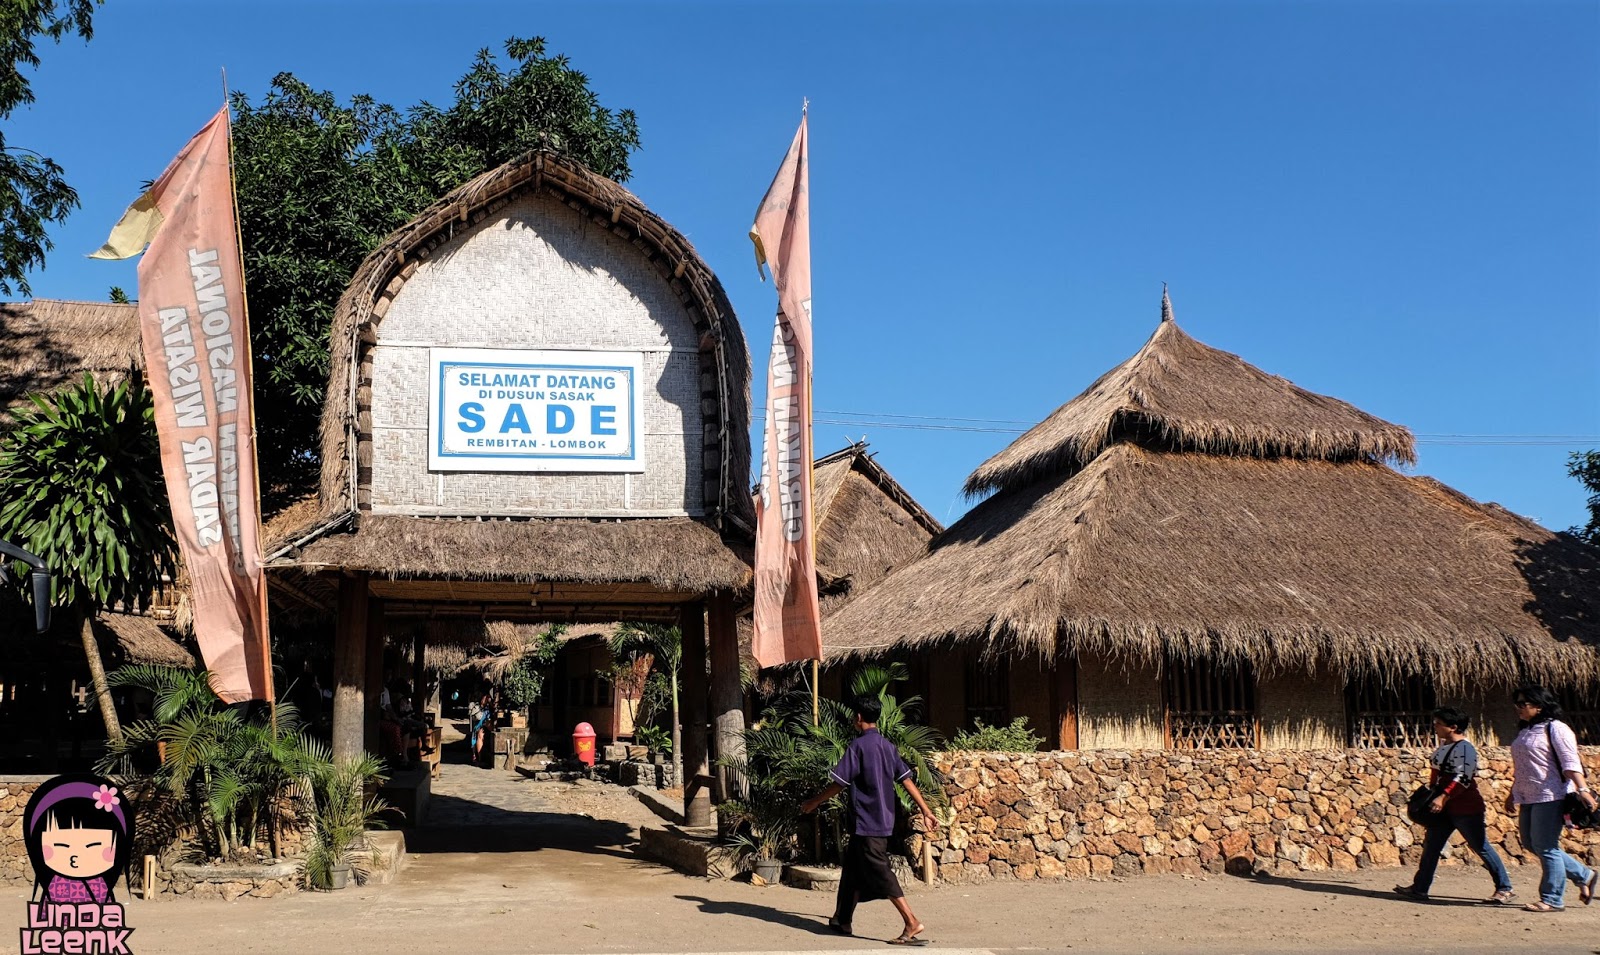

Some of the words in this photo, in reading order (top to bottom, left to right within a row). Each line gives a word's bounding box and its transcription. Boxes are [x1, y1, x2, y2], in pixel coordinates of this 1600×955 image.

[458, 372, 541, 388] SELAMAT
[546, 375, 616, 390] DATANG
[478, 389, 492, 399] DI
[497, 390, 545, 400] DUSUN
[549, 391, 596, 401] SASAK
[457, 401, 617, 435] SADE
[467, 438, 537, 448] REMBITAN
[550, 439, 606, 449] LOMBOK
